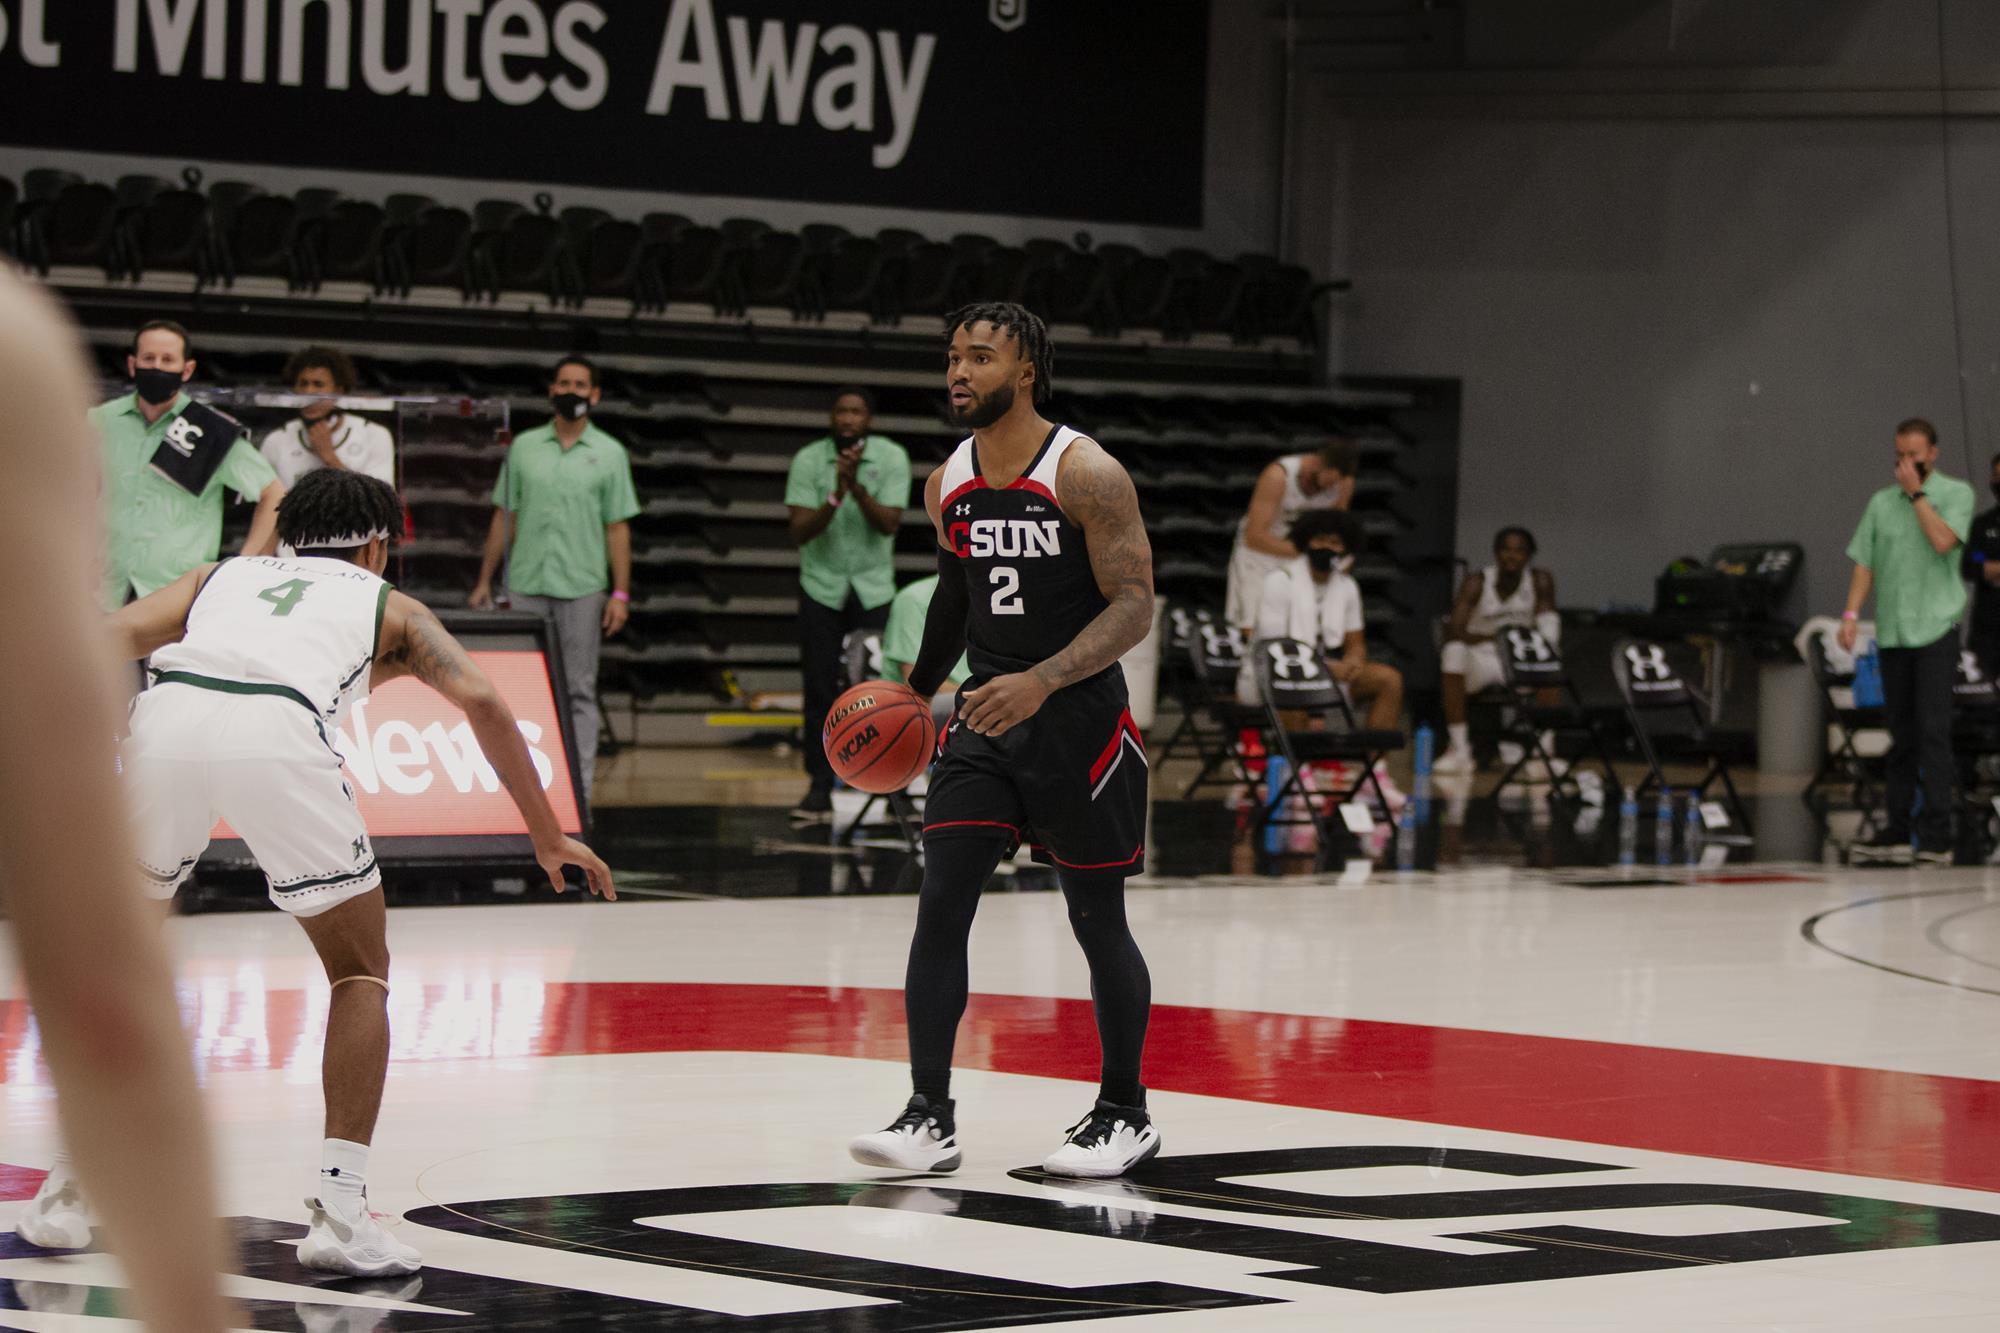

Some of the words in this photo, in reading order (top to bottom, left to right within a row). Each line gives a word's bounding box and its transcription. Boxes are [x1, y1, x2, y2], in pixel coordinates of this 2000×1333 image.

[0, 0, 60, 68] t
[113, 0, 609, 111] Minutes
[645, 0, 937, 168] Away
[949, 519, 1061, 558] CSUN
[257, 578, 315, 616] 4
[989, 566, 1025, 615] 2
[836, 724, 880, 766] NCAA
